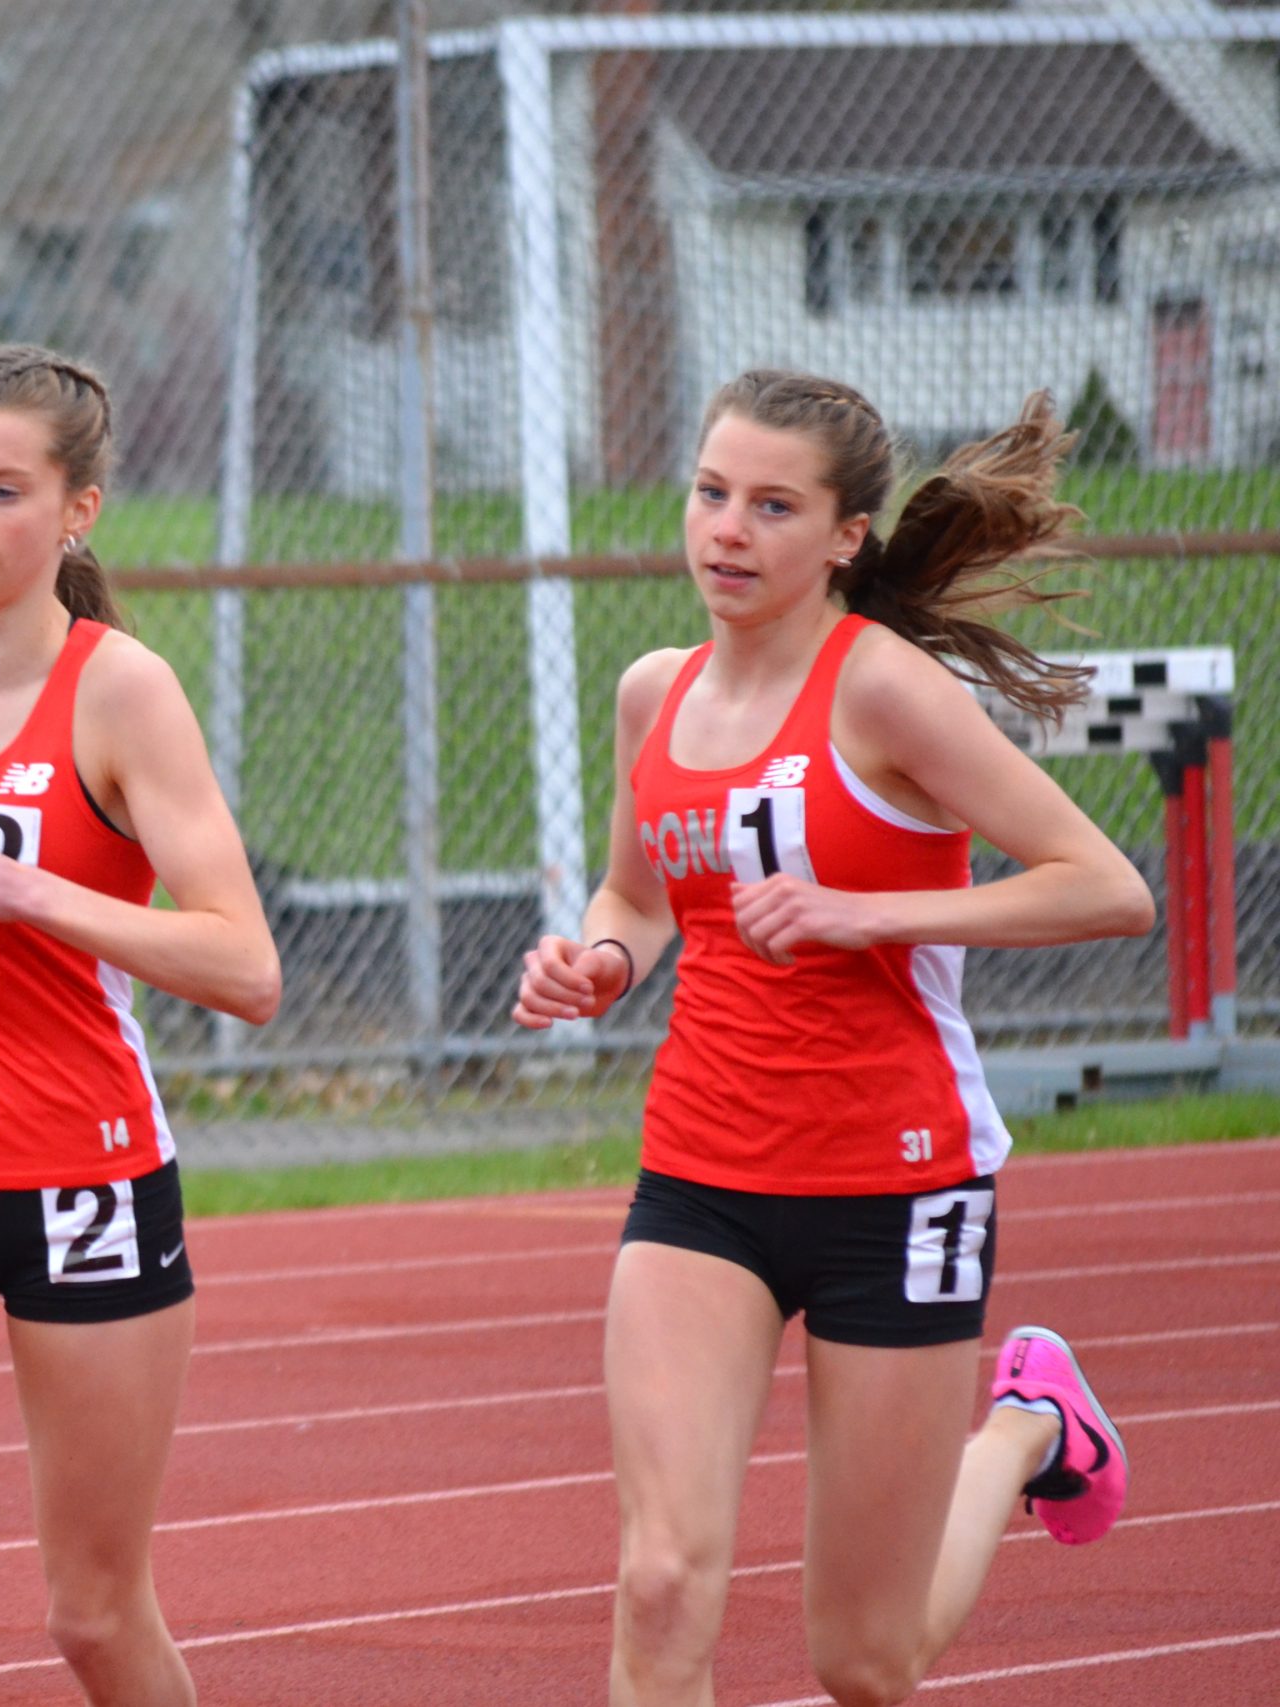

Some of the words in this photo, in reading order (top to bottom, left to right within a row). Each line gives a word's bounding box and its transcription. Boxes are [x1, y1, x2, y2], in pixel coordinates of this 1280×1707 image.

[740, 797, 782, 879] 1
[99, 1117, 130, 1152] 14
[901, 1129, 933, 1162] 31
[56, 1183, 124, 1274] 2
[928, 1201, 967, 1294] 1
